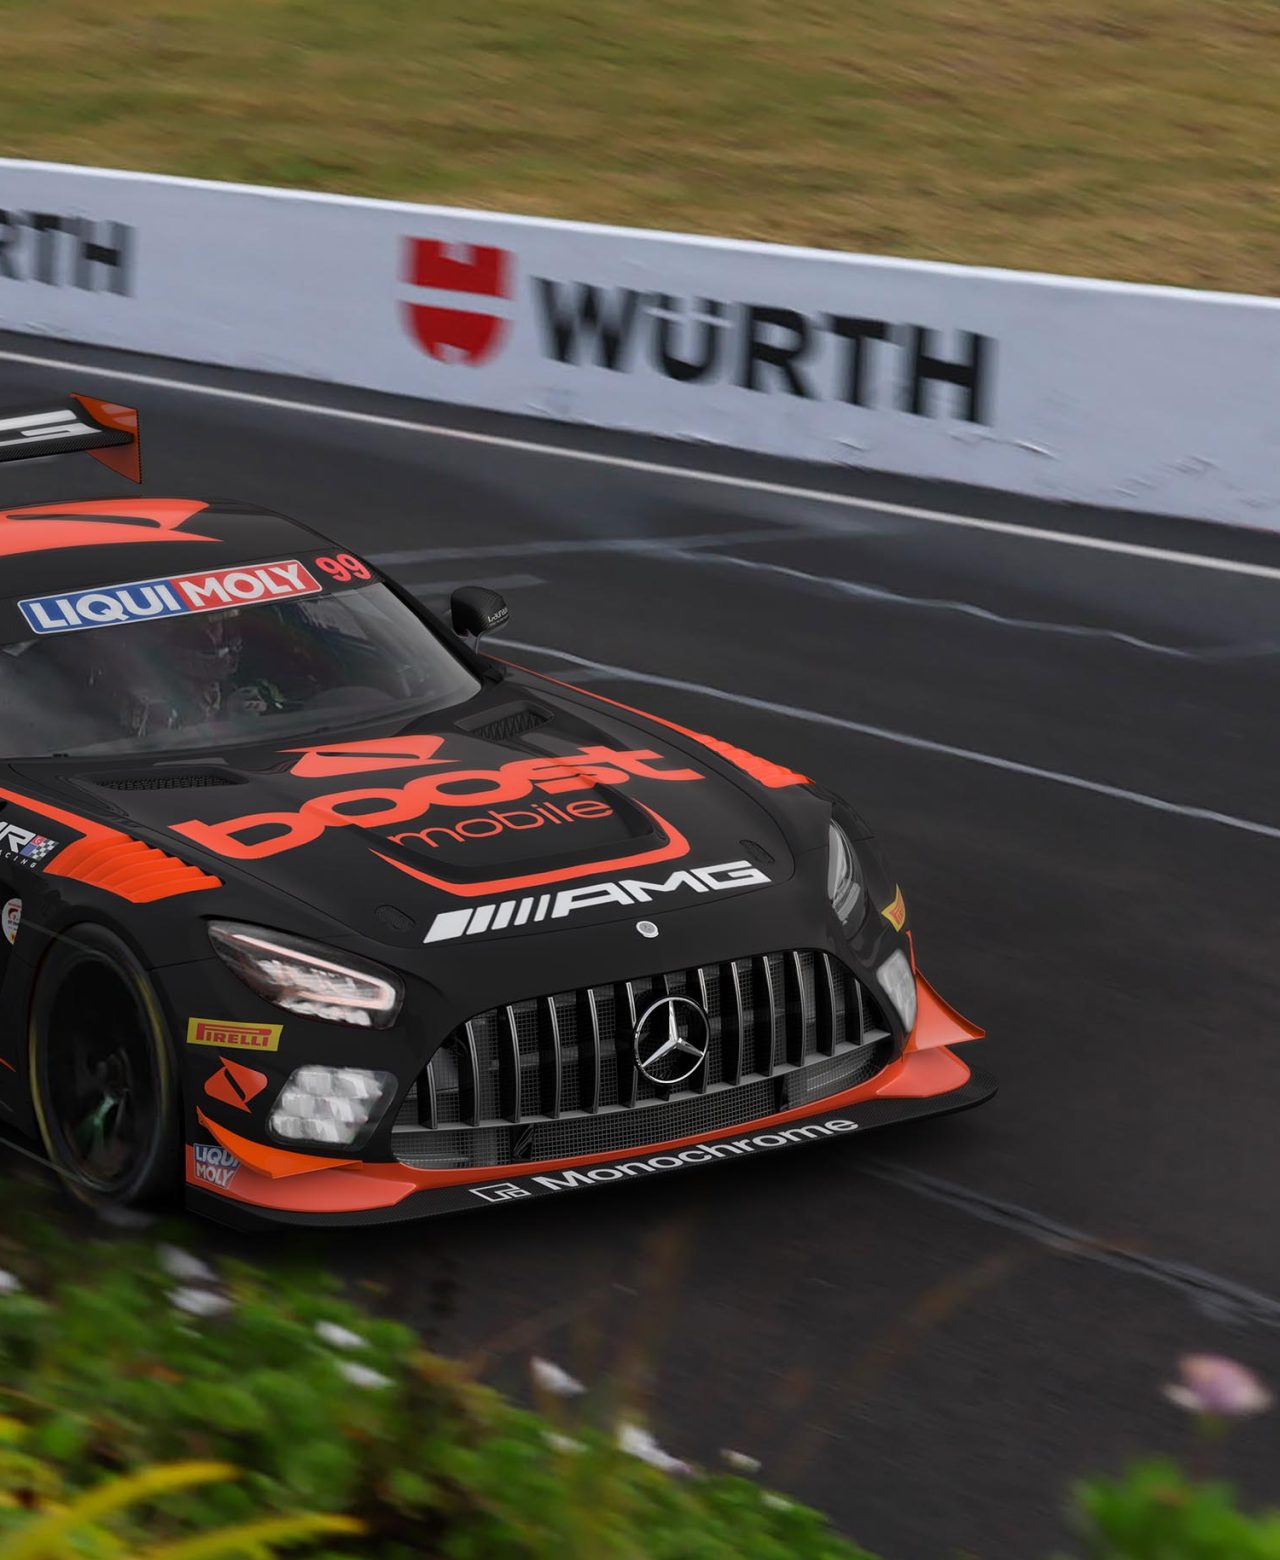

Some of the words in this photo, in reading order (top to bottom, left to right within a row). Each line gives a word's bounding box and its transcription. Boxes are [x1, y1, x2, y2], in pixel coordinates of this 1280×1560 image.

[531, 275, 996, 426] WÜRTH
[29, 583, 183, 629] LIQUI
[179, 564, 307, 607] MOLY
[315, 553, 372, 582] 99
[167, 745, 706, 860] boost
[387, 800, 613, 848] mobile
[552, 860, 771, 918] AMG
[196, 1023, 272, 1047] PIRELLI
[195, 1163, 235, 1188] MOLY
[531, 1117, 860, 1192] Monochrome
